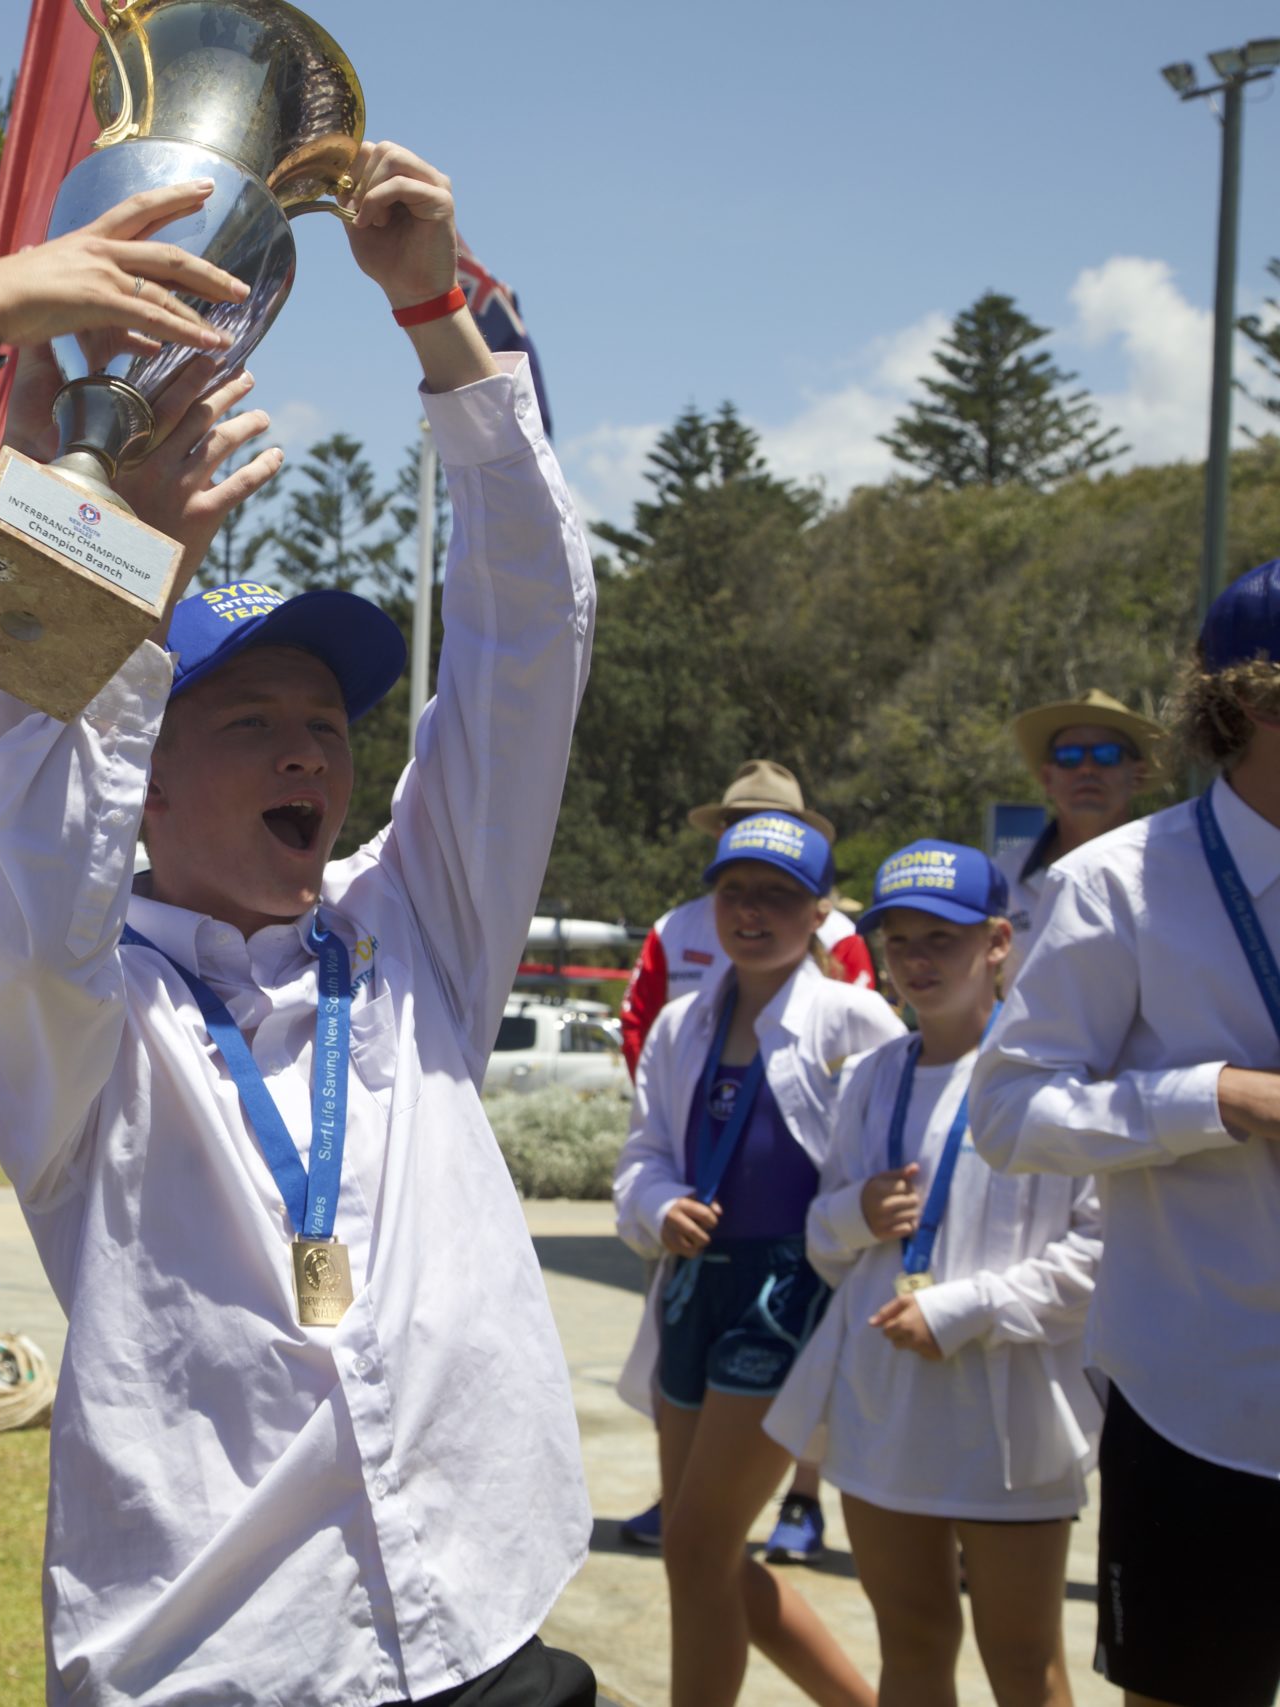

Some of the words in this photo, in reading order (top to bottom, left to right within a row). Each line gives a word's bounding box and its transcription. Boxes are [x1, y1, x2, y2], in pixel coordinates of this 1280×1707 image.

[8, 495, 76, 540] INTERBRANCH
[77, 535, 152, 581] CHAMPIONSHIP
[28, 520, 84, 558] Champion
[85, 552, 124, 580] Branch
[325, 980, 340, 1014] South
[324, 1017, 338, 1047] New
[322, 1050, 340, 1098] Saving
[321, 1101, 335, 1128] Life
[318, 1128, 333, 1161] Surf
[310, 1196, 327, 1240] Wales
